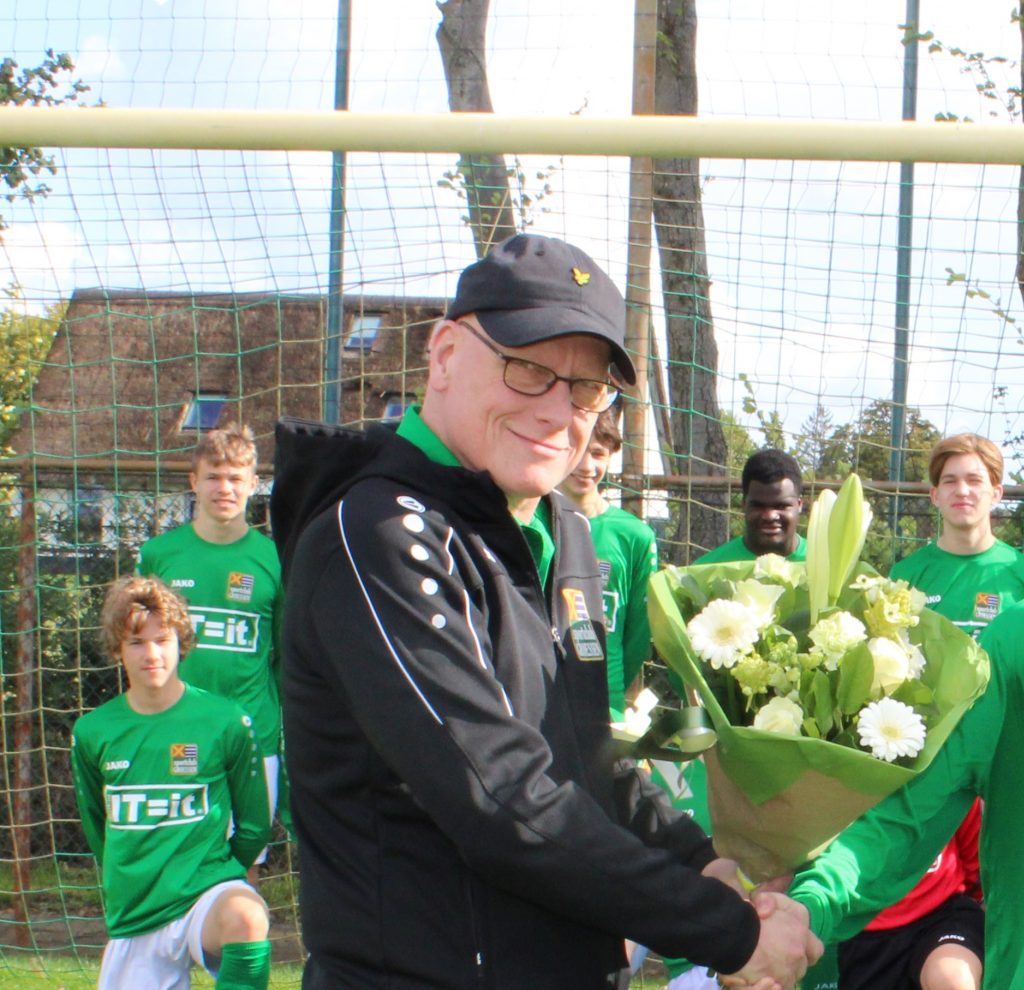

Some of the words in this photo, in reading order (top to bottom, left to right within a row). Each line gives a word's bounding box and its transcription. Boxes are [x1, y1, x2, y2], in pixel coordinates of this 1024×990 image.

[188, 614, 249, 646] T=it
[106, 760, 130, 771] JAKO
[814, 982, 839, 990] JAK
